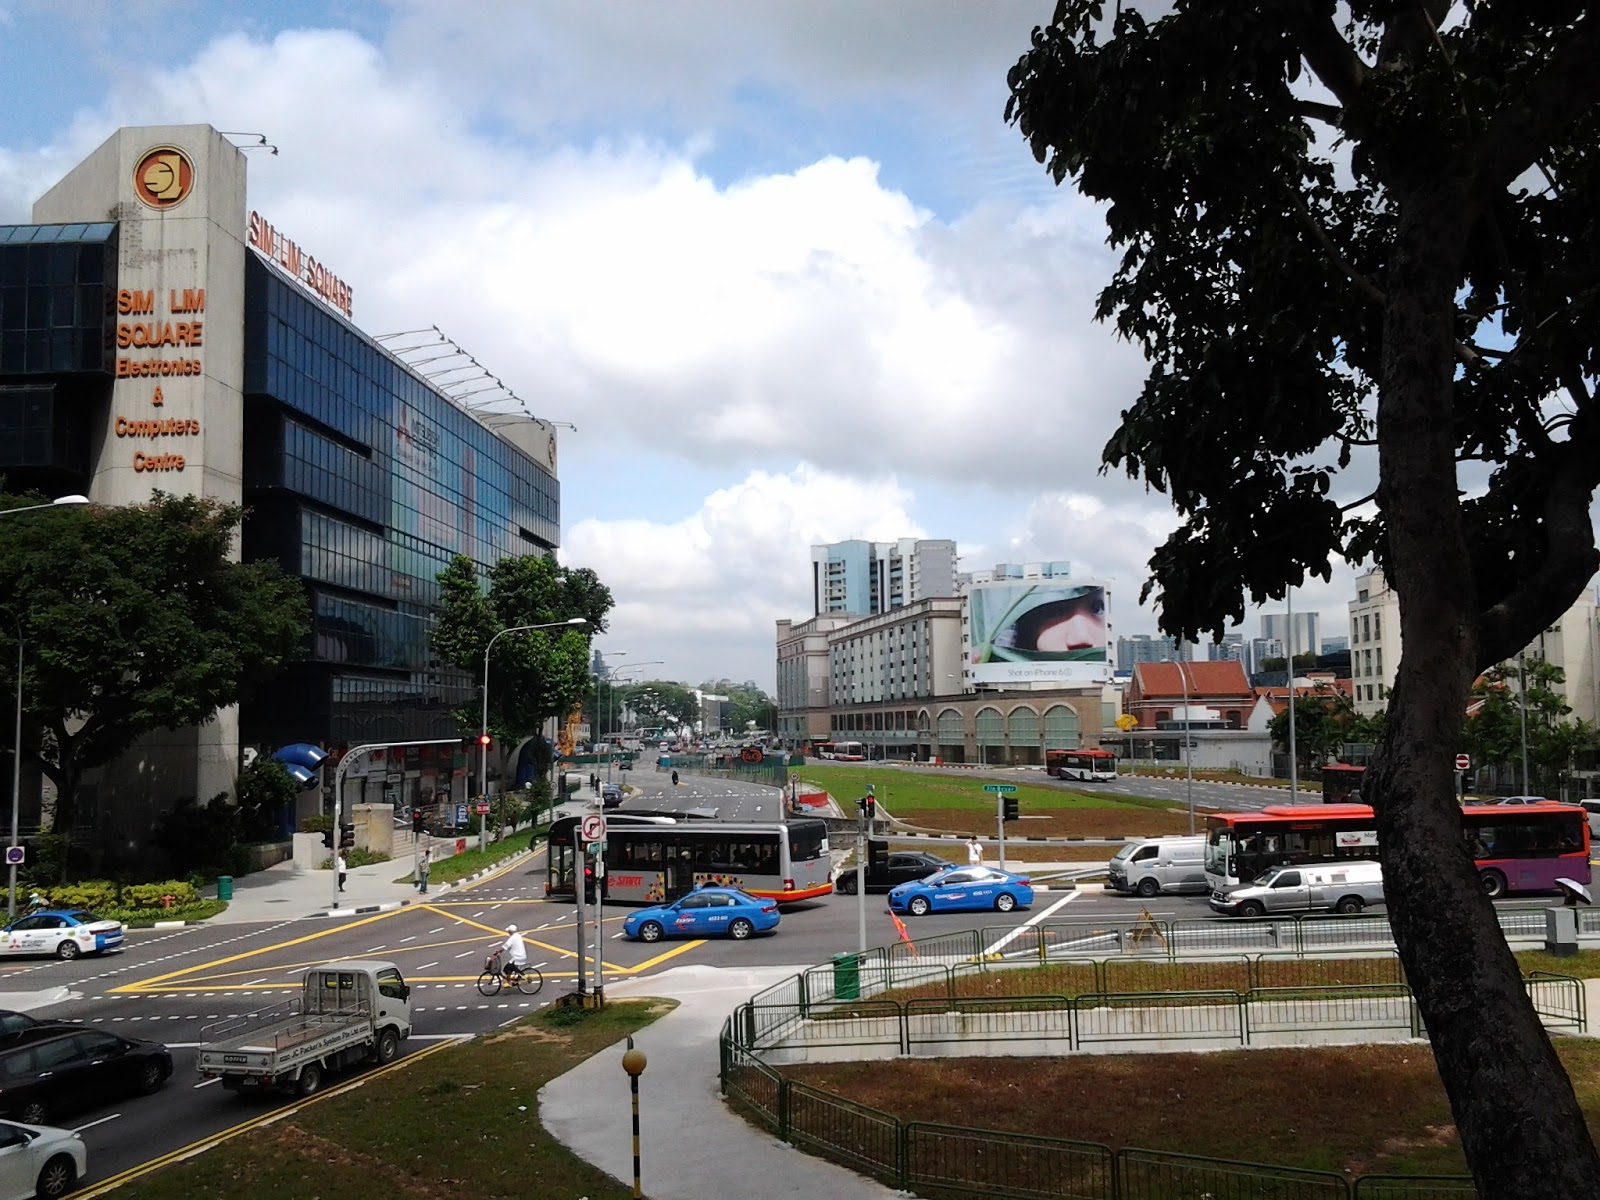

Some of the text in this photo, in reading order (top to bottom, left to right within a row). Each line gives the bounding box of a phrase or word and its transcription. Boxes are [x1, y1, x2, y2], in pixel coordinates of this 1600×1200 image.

[249, 210, 353, 317] SIM LIM SQUARE
[118, 288, 205, 314] SIM LIM
[117, 321, 203, 347] SQUARE
[117, 357, 202, 377] Electronics
[152, 385, 163, 405] &
[115, 416, 200, 440] Computers
[133, 451, 186, 471] Centre
[1007, 669, 1023, 677] Shot
[1023, 669, 1034, 677] on
[1034, 668, 1058, 676] iPhone
[616, 876, 643, 887] SMRT
[323, 1035, 342, 1047] System
